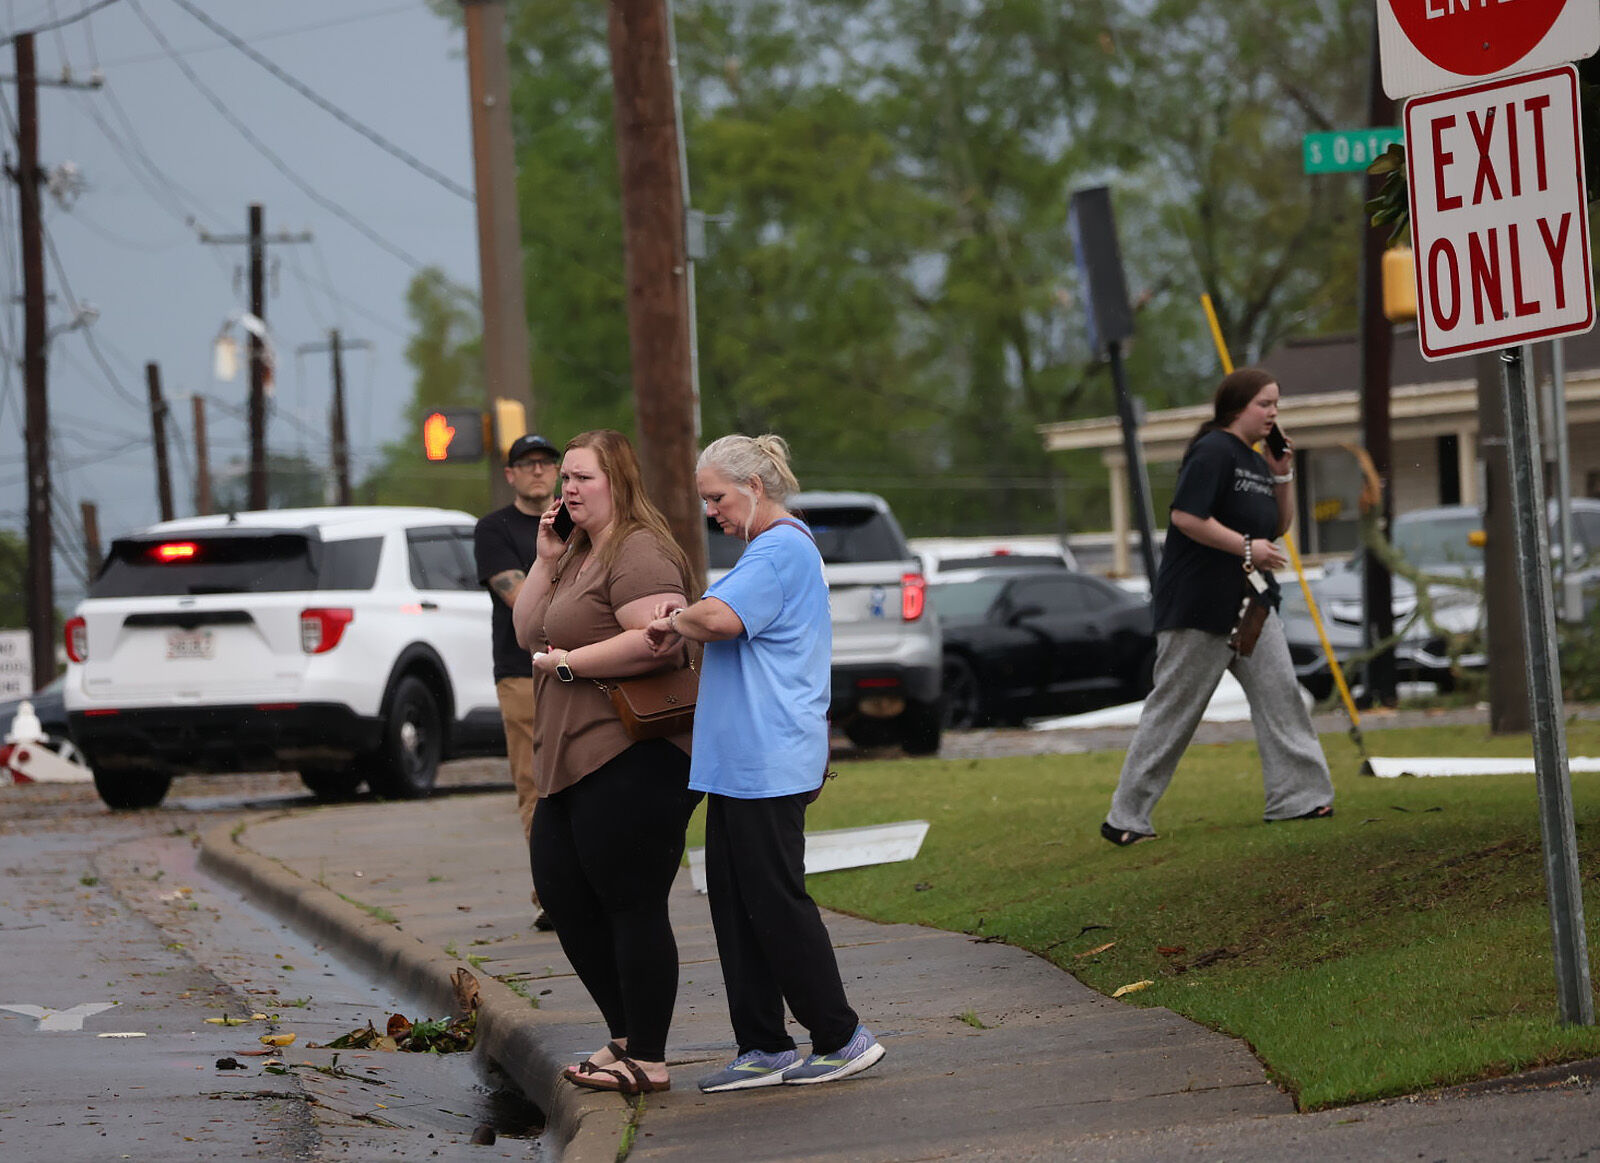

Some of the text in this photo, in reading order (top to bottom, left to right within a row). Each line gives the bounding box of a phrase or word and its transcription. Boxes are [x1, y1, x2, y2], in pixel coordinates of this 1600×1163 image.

[1333, 134, 1404, 165] Oat
[1431, 94, 1550, 213] EXIT
[1427, 212, 1571, 332] ONLY
